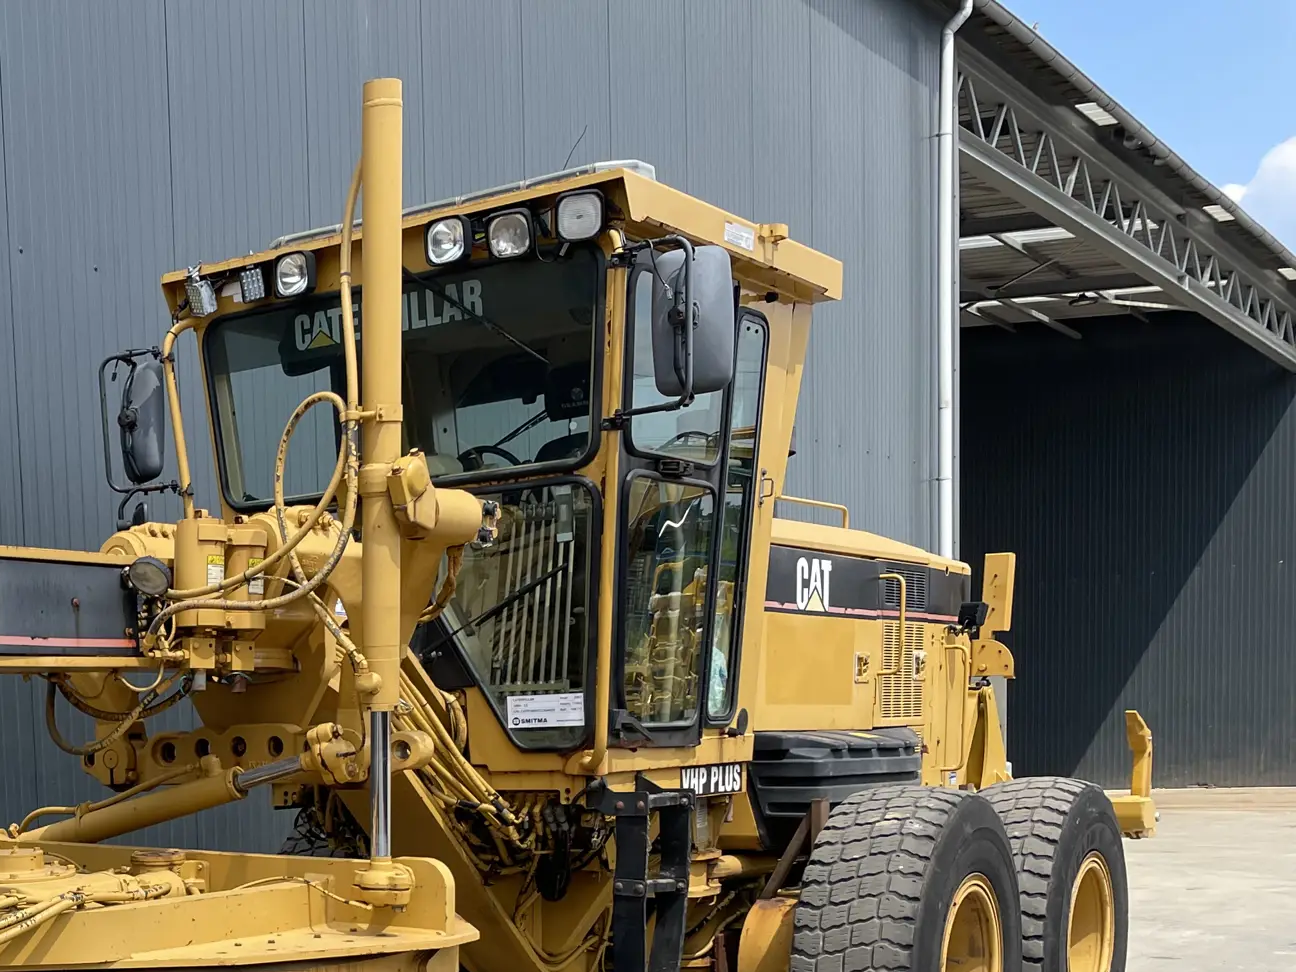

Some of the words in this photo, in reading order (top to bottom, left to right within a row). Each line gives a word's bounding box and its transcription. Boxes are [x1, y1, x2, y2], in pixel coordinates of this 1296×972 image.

[295, 279, 483, 351] CATEILLAR
[796, 556, 832, 612] CAT
[681, 767, 708, 795] VHP
[710, 764, 741, 793] PLUS
